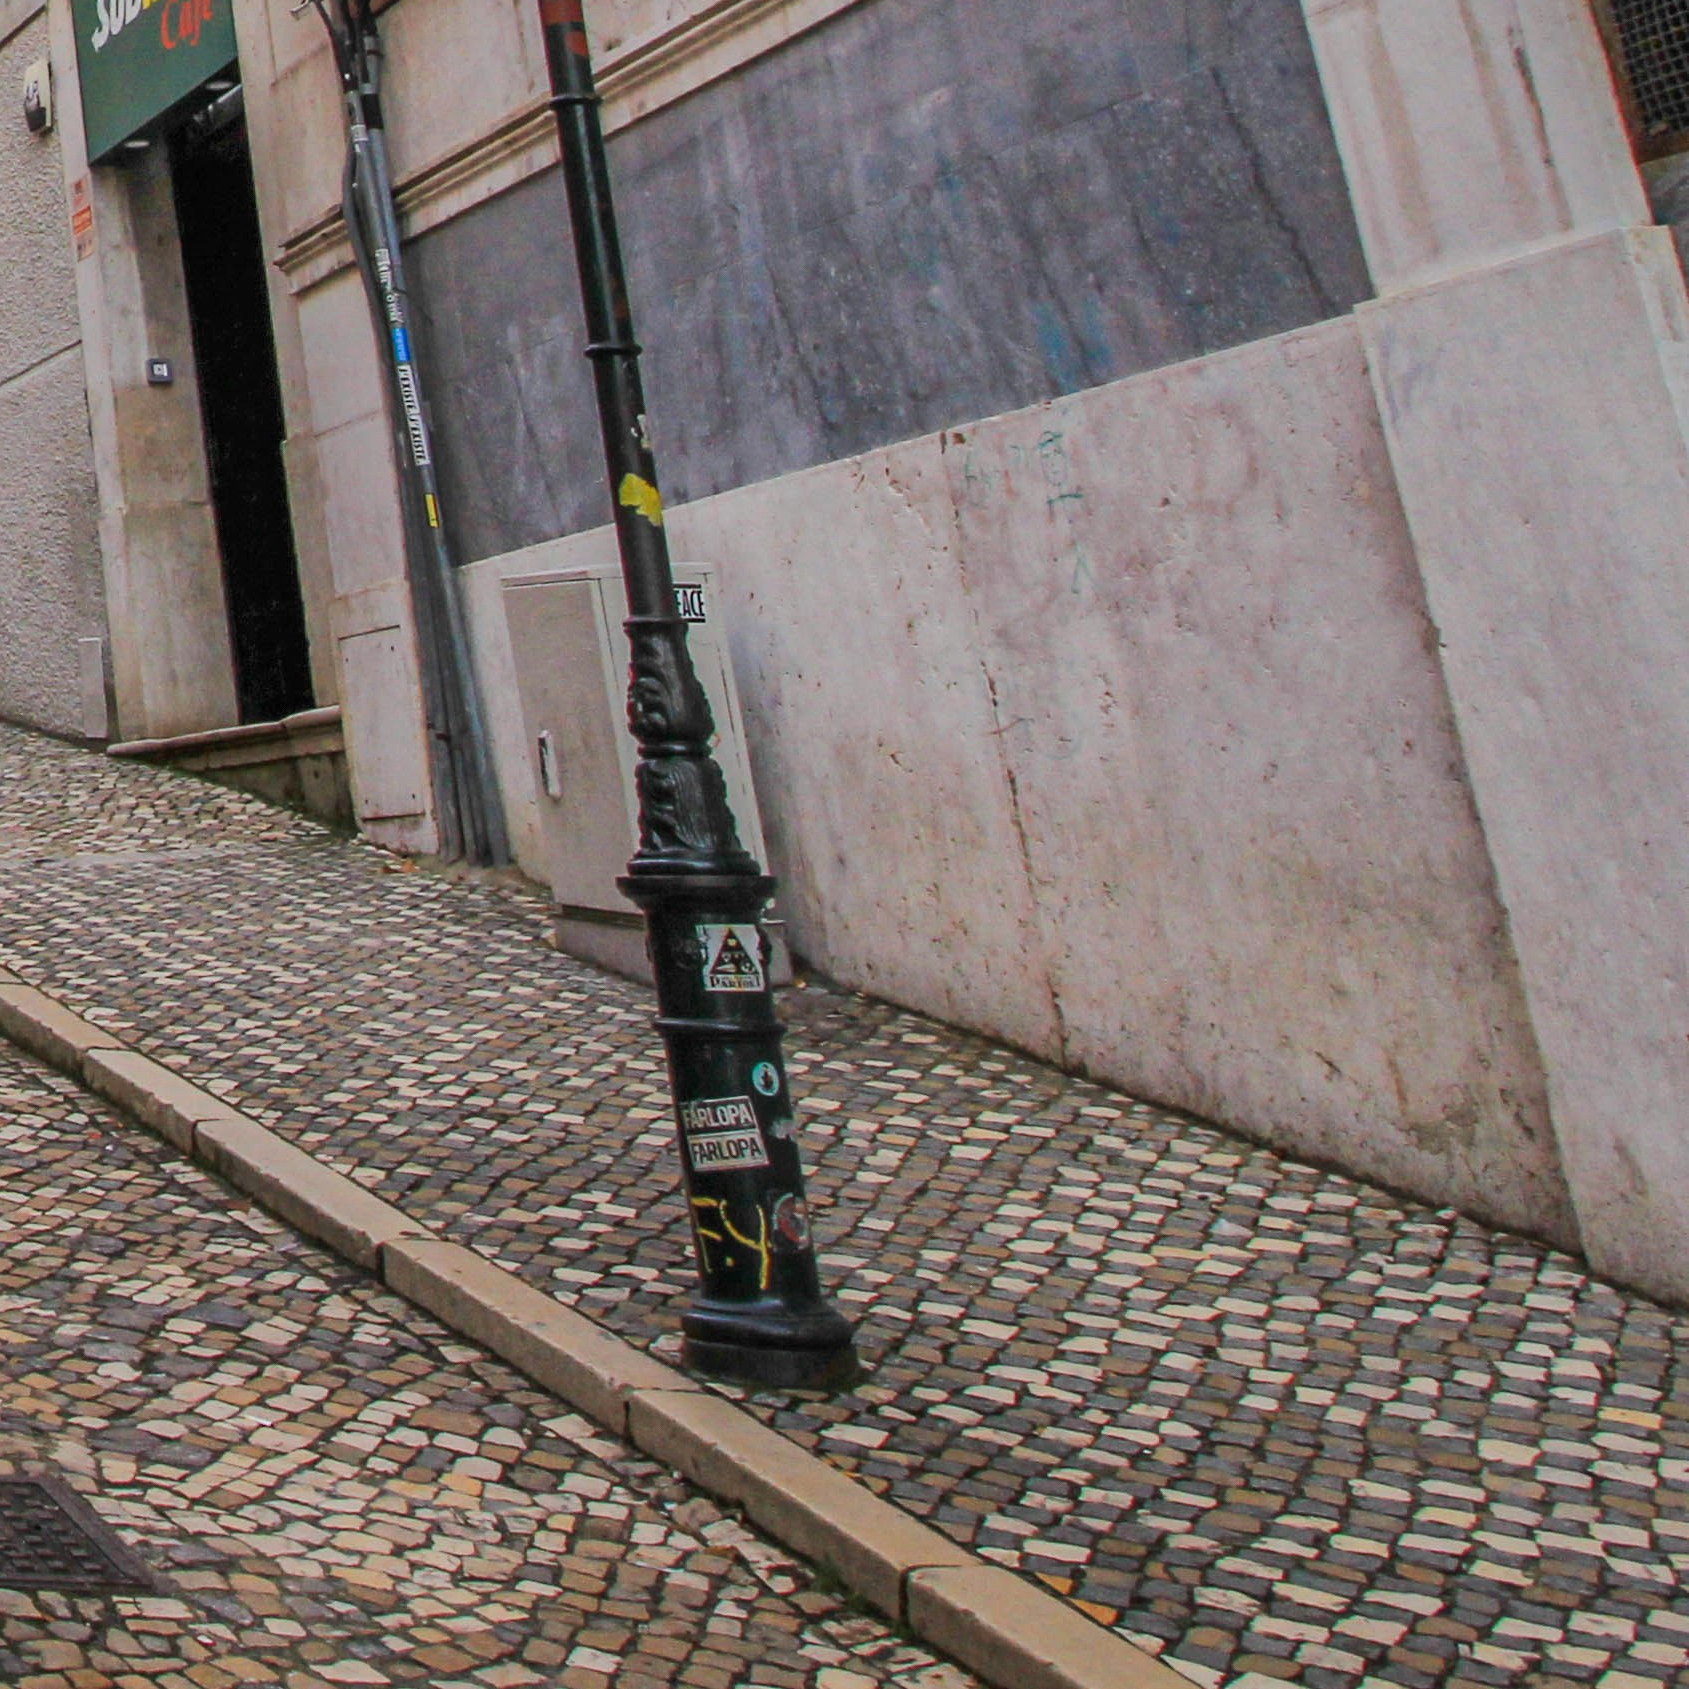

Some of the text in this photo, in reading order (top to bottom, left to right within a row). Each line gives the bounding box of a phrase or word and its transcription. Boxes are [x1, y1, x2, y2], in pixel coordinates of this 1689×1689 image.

[672, 590, 705, 617] EACE
[683, 1103, 753, 1130] FARLOPA
[691, 1137, 762, 1163] FARLOPA
